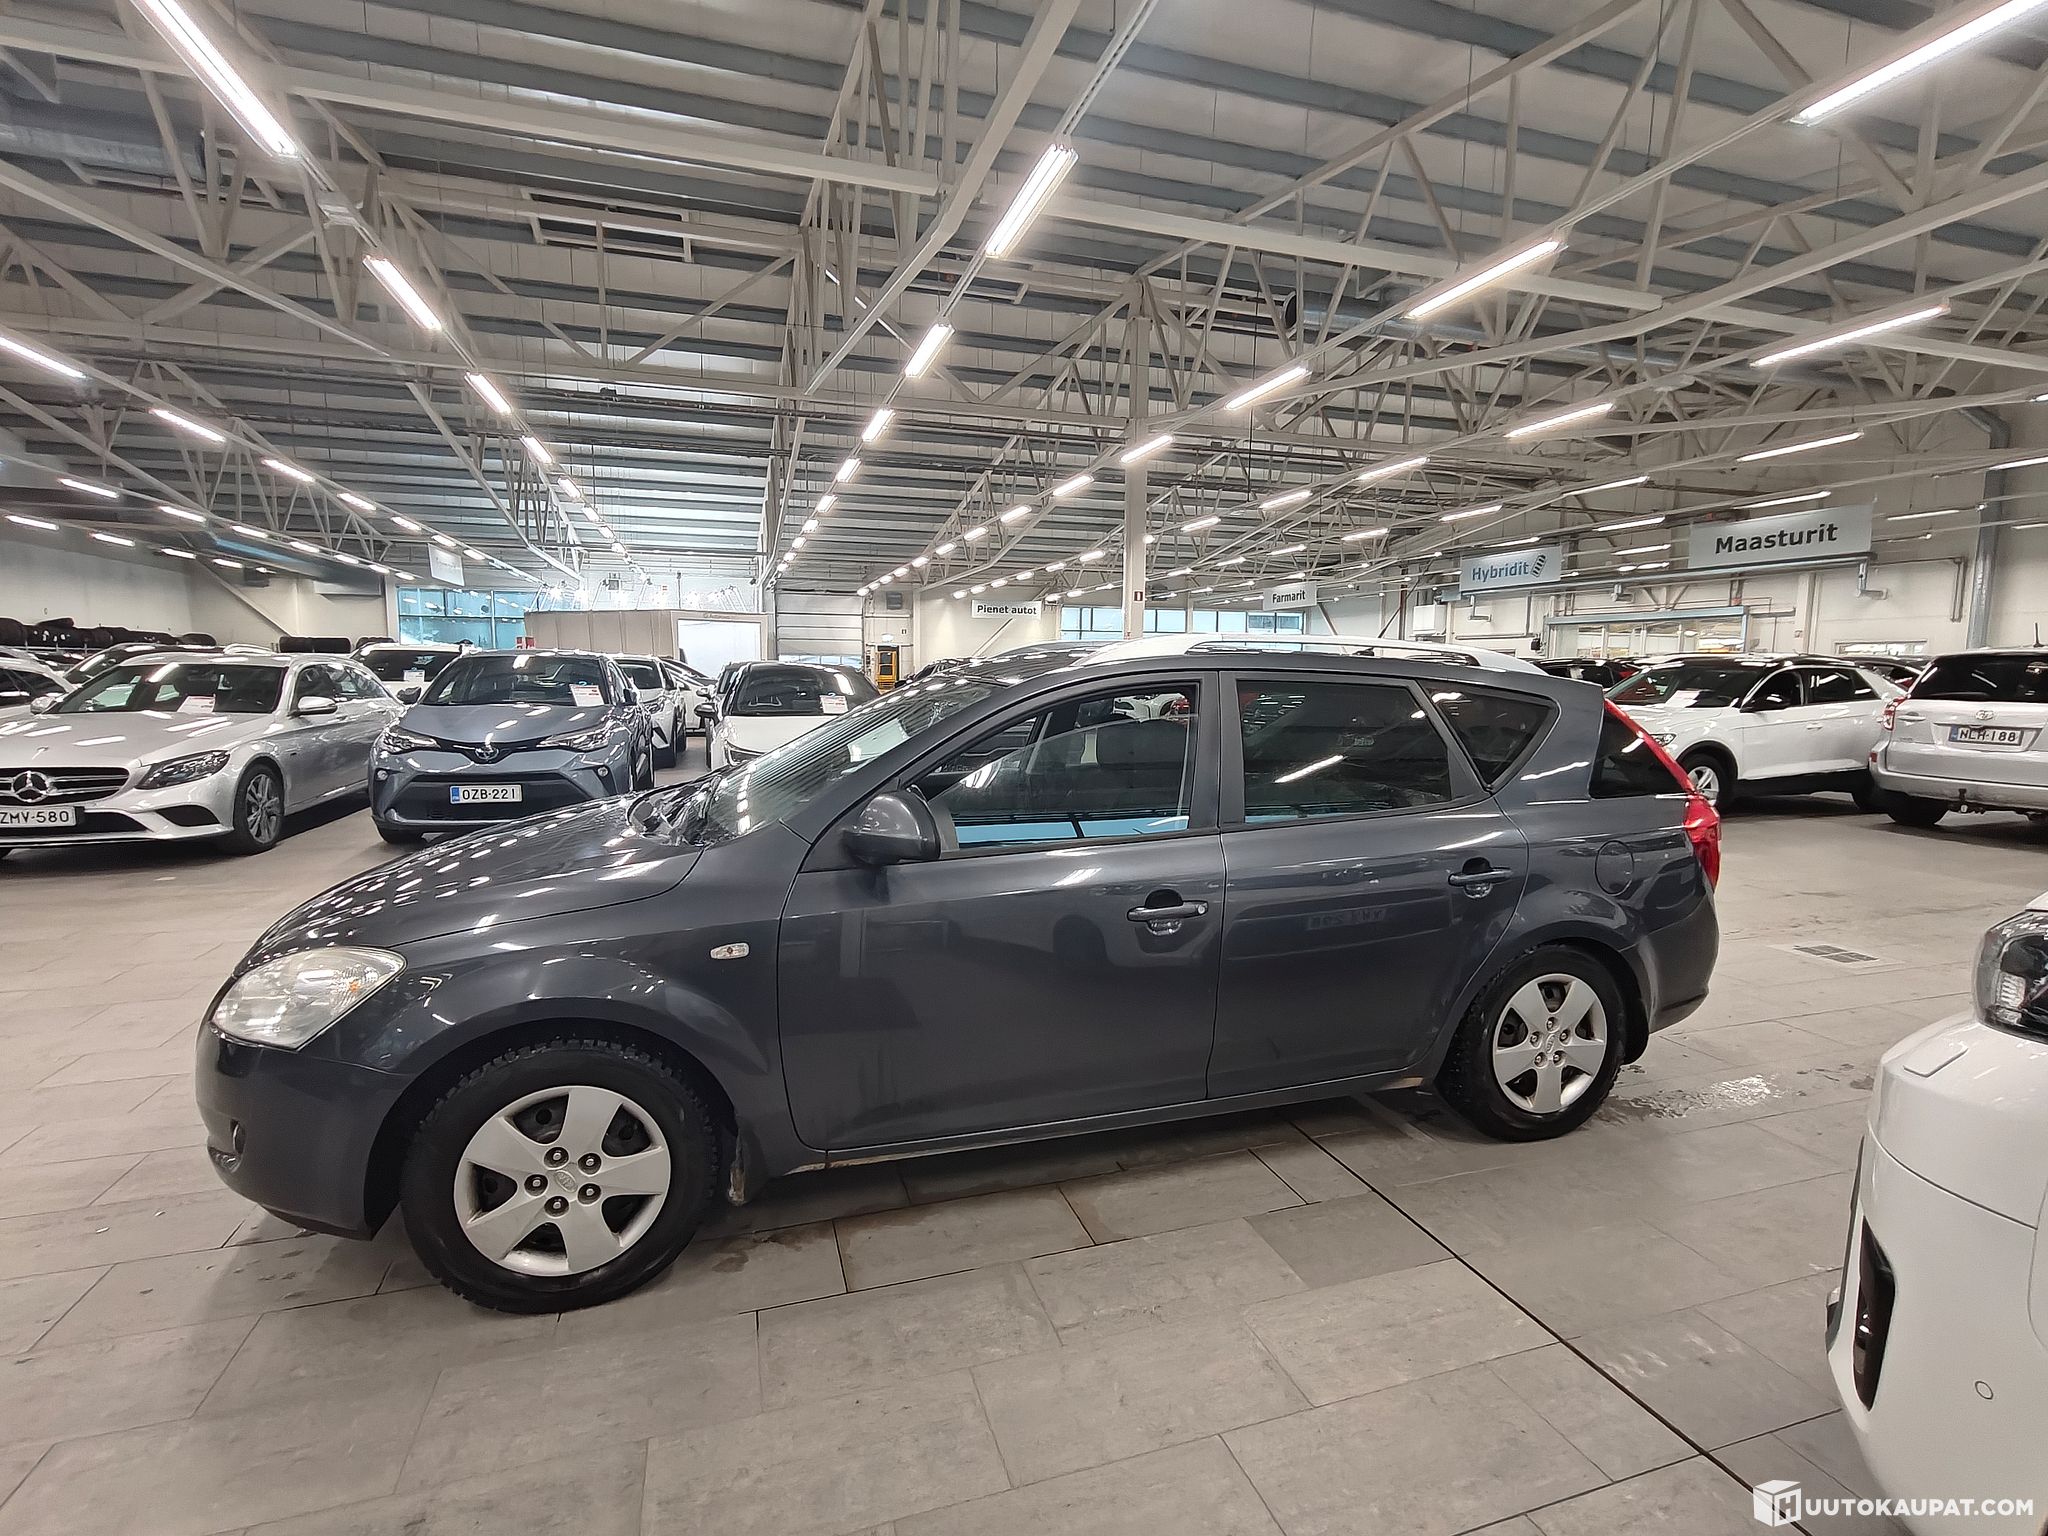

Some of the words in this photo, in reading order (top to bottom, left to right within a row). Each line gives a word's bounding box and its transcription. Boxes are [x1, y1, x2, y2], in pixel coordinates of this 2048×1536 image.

[1715, 523, 1838, 554] Maasturit
[1472, 561, 1529, 582] Hybridit
[1272, 589, 1306, 603] Farmarit
[977, 604, 1009, 614] Pienet
[1011, 606, 1037, 615] autot
[462, 788, 515, 800] OZB-221
[0, 810, 69, 824] ZMV-580
